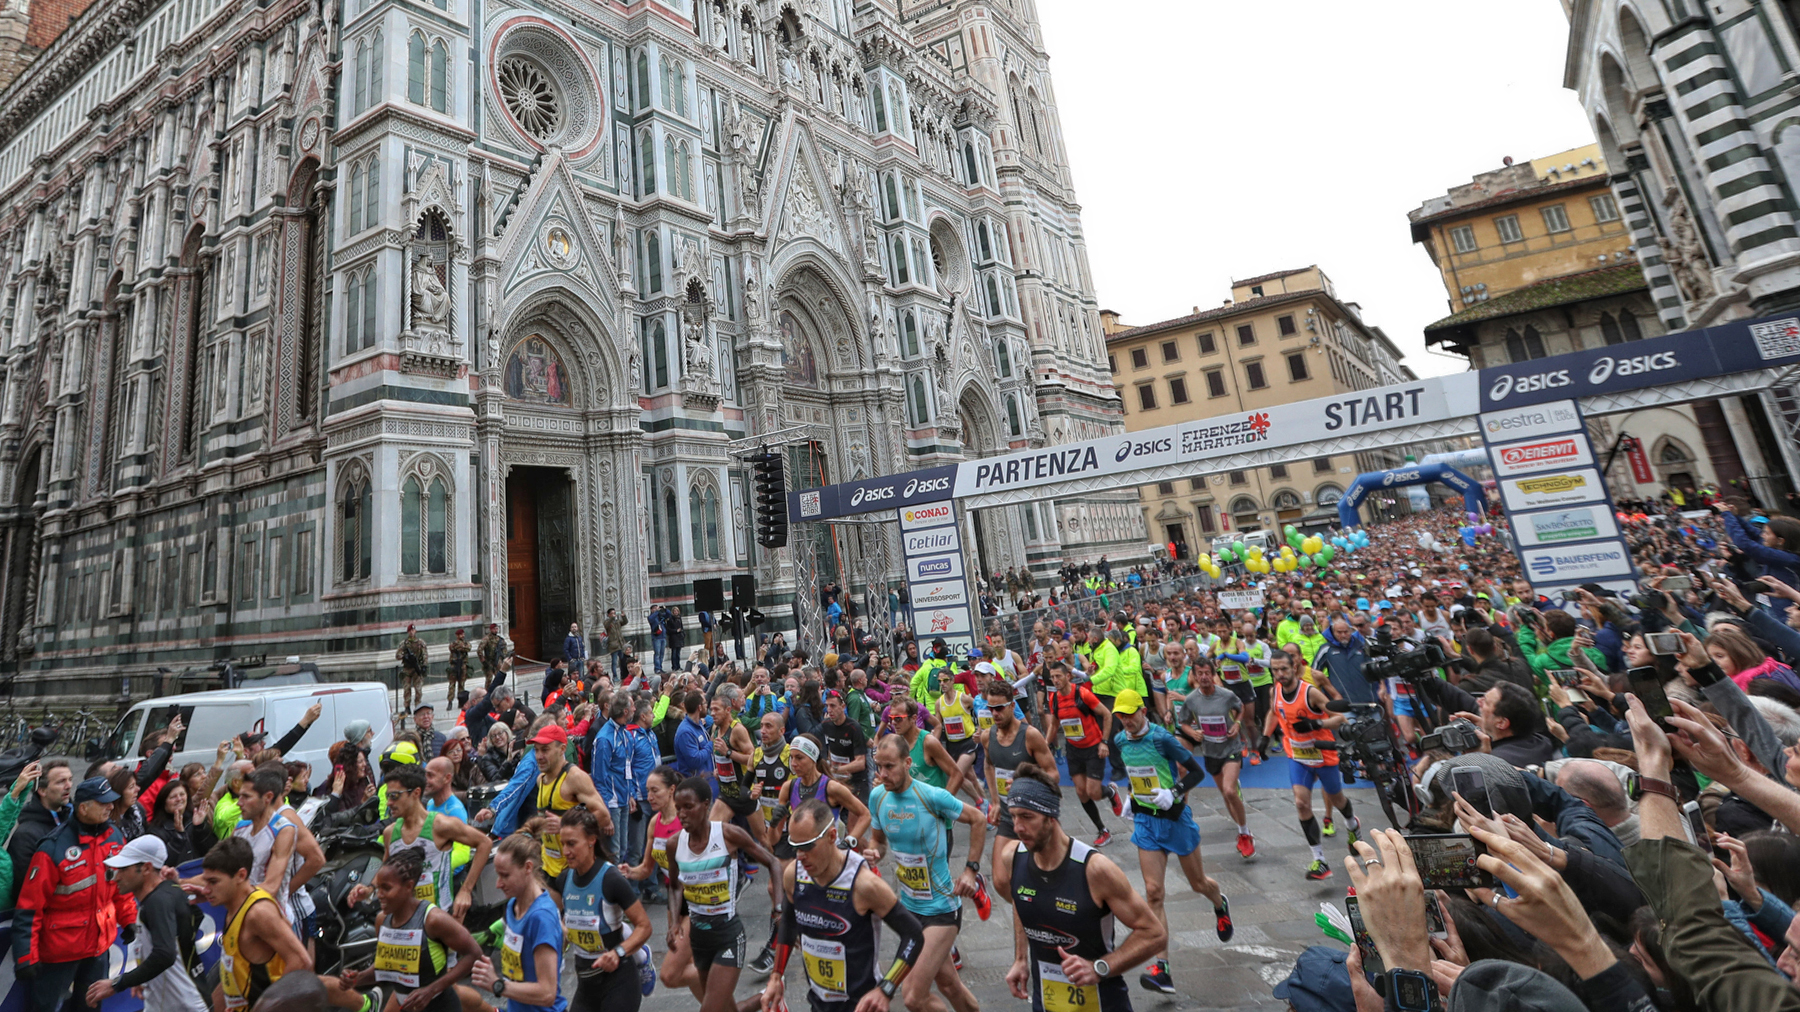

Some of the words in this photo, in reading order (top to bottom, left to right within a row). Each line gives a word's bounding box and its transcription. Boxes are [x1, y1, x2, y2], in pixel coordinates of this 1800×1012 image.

[1325, 387, 1425, 431] START
[1501, 412, 1547, 430] estra
[1182, 420, 1252, 442] FIRENZE
[1182, 429, 1268, 454] MARATHON
[1524, 442, 1575, 459] ENERVIT
[975, 446, 1099, 488] PARTENZA
[914, 506, 949, 519] CONAD
[909, 534, 953, 550] Cetilar
[920, 562, 949, 572] nuncas
[1556, 552, 1620, 565] BAUERFEIND
[914, 593, 960, 604] UNIVERSOSPORT
[1142, 778, 1152, 788] 70
[1056, 901, 1078, 911] MdS
[578, 931, 595, 944] F29
[377, 944, 418, 961] MOHAMMED
[818, 959, 833, 978] 65
[1067, 986, 1086, 1006] 26
